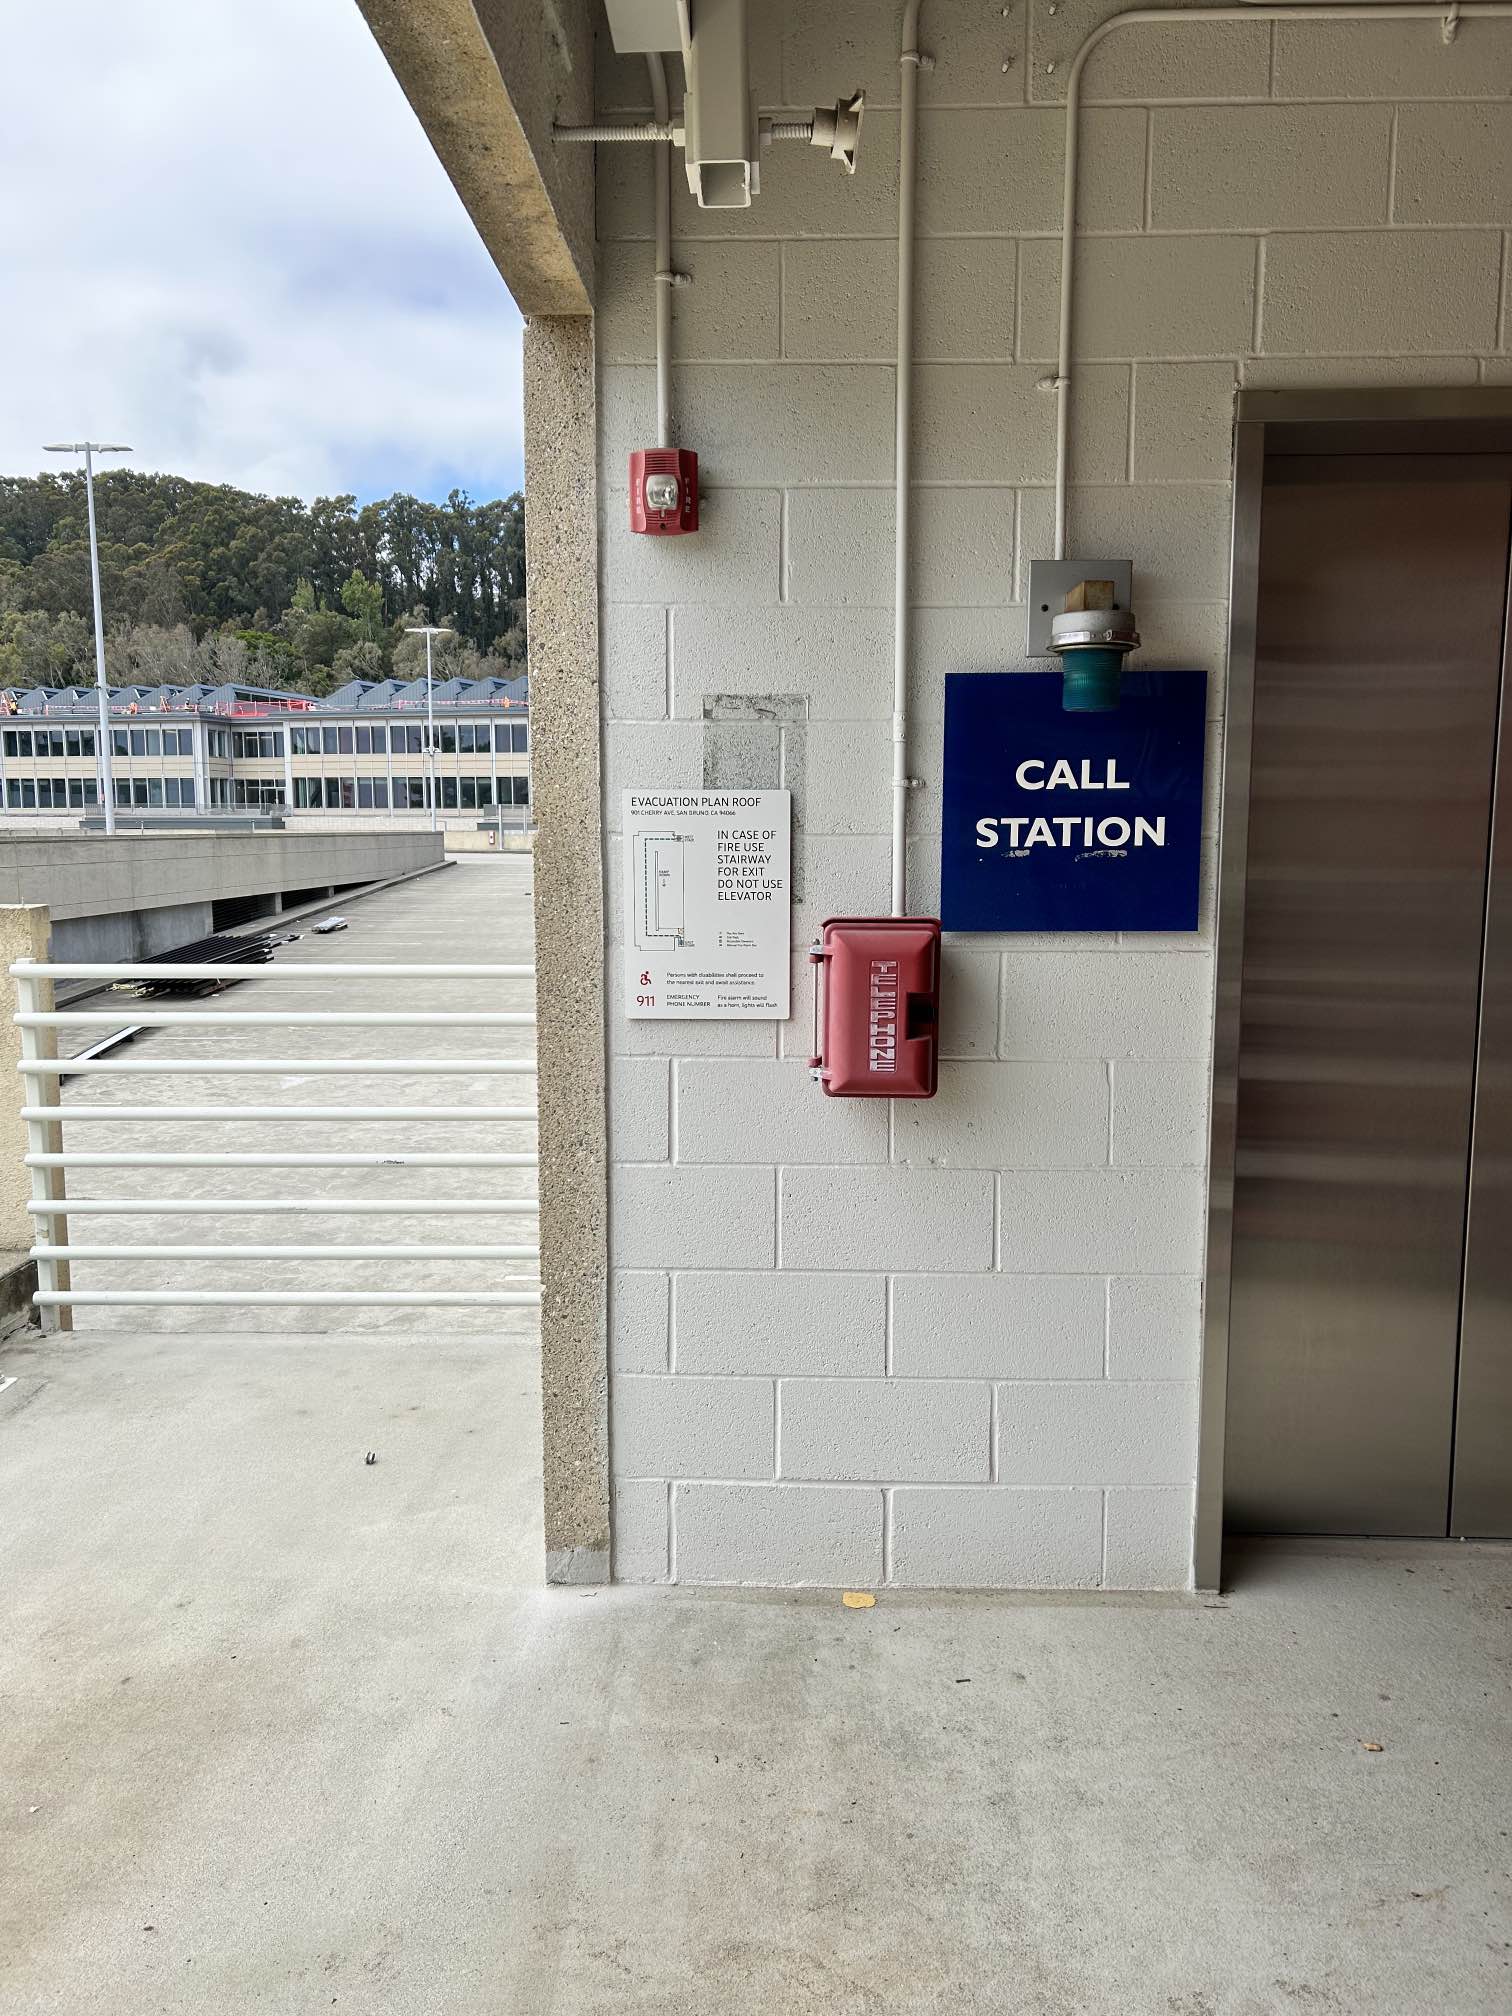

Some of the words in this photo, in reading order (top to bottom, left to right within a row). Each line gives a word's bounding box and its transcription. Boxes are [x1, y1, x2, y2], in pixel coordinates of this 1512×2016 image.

[1015, 759, 1130, 790] CALL
[631, 796, 698, 807] EVACUATION
[701, 797, 729, 807] PLAN
[732, 797, 762, 807] ROOF
[717, 830, 729, 840] IN
[732, 830, 760, 840] CASE
[762, 830, 777, 840] OF
[975, 816, 1166, 848] STATION
[717, 842, 741, 852] FIRE
[743, 842, 765, 852] USE
[717, 854, 772, 864] STAIRWAY
[717, 866, 739, 877] FOR
[742, 866, 765, 877] EXIT
[717, 879, 733, 889] DO
[736, 879, 759, 889] NOT
[762, 879, 783, 889] USE
[717, 891, 772, 901] ELEVATOR
[636, 995, 655, 1007] 911
[869, 960, 897, 1073] TELEPHONE
